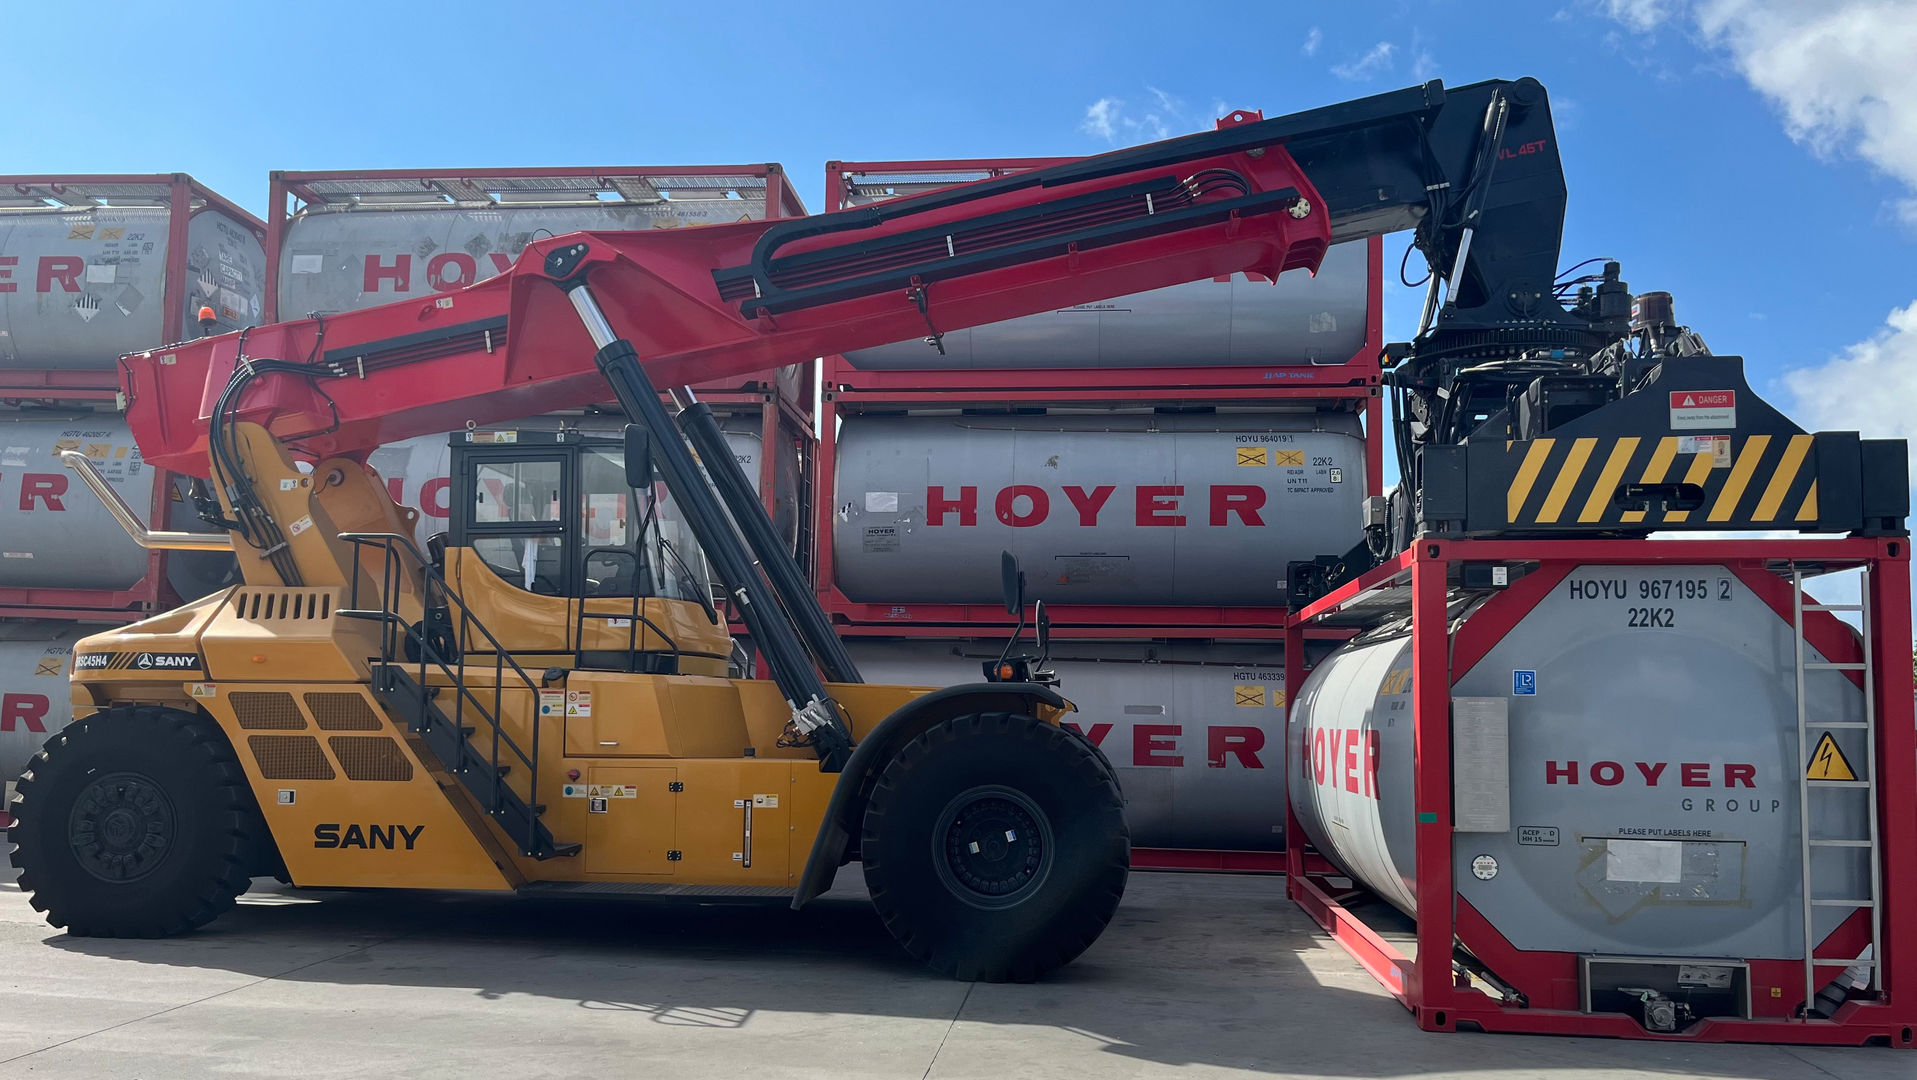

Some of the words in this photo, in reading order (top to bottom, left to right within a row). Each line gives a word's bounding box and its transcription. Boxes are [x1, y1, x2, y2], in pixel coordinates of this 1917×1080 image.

[1519, 139, 1546, 155] 45T
[1698, 395, 1728, 404] DANGER
[1312, 457, 1333, 466] 22K2
[926, 485, 1266, 528] HOYER
[1569, 580, 1627, 600] HOYU
[1639, 580, 1708, 600] 967195
[1719, 579, 1731, 600] 2
[1628, 608, 1675, 628] 22K2
[44, 647, 66, 655] HGTU
[155, 656, 196, 667] SANY
[1233, 672, 1256, 680] HGTU
[1258, 672, 1285, 681] 463339
[1522, 674, 1532, 686] LR
[1302, 727, 1381, 801] HOYER
[1545, 760, 1758, 789] HOYER
[1681, 798, 1782, 814] GROUP
[314, 824, 426, 850] SANY
[1618, 828, 1646, 836] PLEASE
[1648, 828, 1662, 836] PUT
[1664, 829, 1691, 837] LABELS
